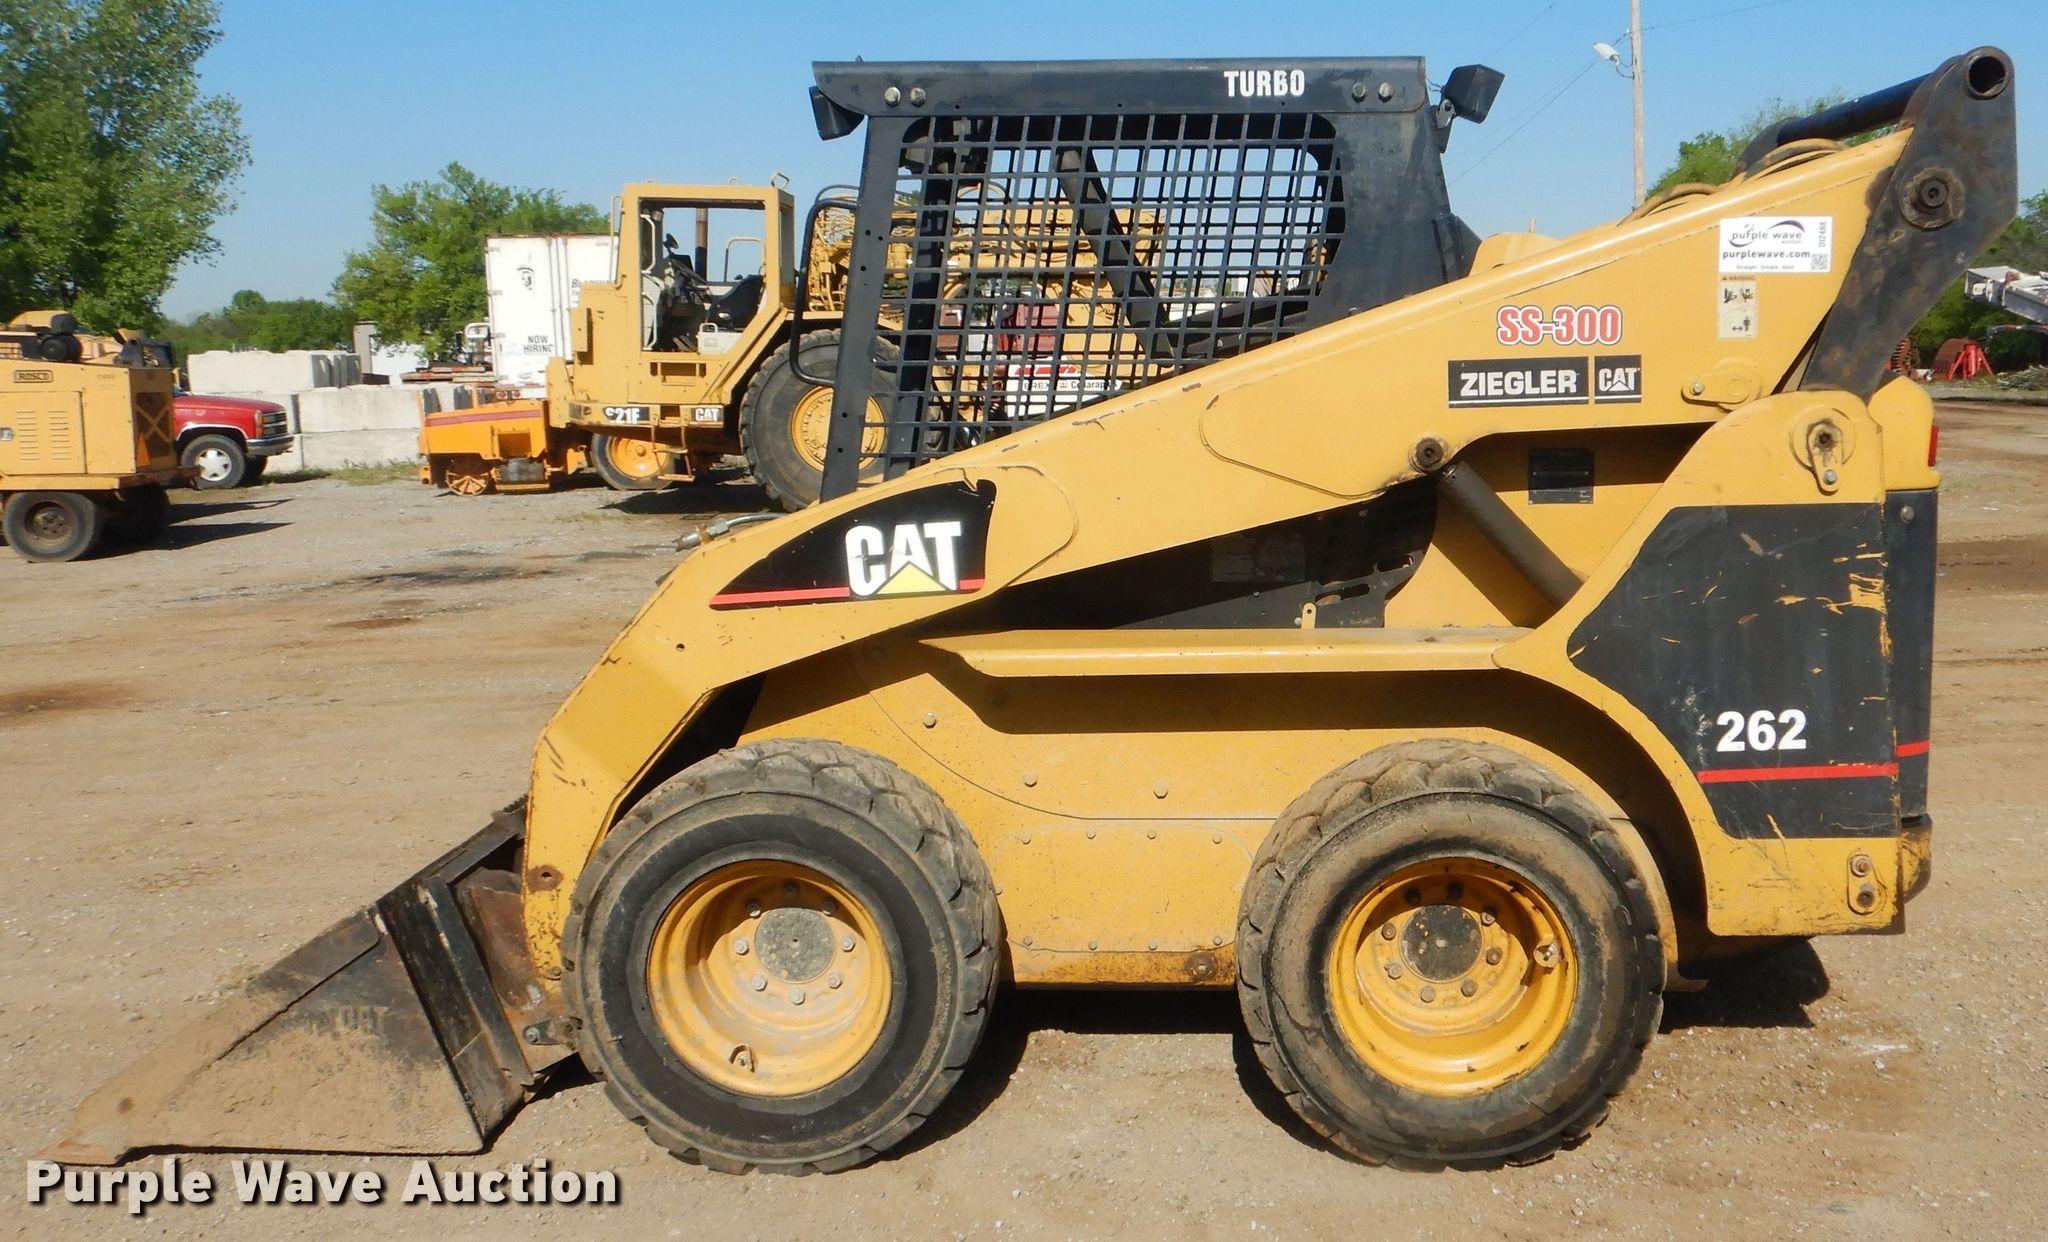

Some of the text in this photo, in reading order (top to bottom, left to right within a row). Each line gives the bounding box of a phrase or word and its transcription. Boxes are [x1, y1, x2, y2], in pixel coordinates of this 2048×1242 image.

[1223, 69, 1305, 97] TURBO
[1732, 229, 1768, 240] purple
[1722, 249, 1811, 260] purplewave.com
[1496, 305, 1622, 346] SS-300
[528, 335, 548, 344] NOW
[1460, 369, 1578, 397] ZIEGLER
[1599, 367, 1637, 392] CAT
[695, 407, 719, 422] CAT
[845, 521, 962, 596] CAT
[1716, 709, 1807, 752] 262
